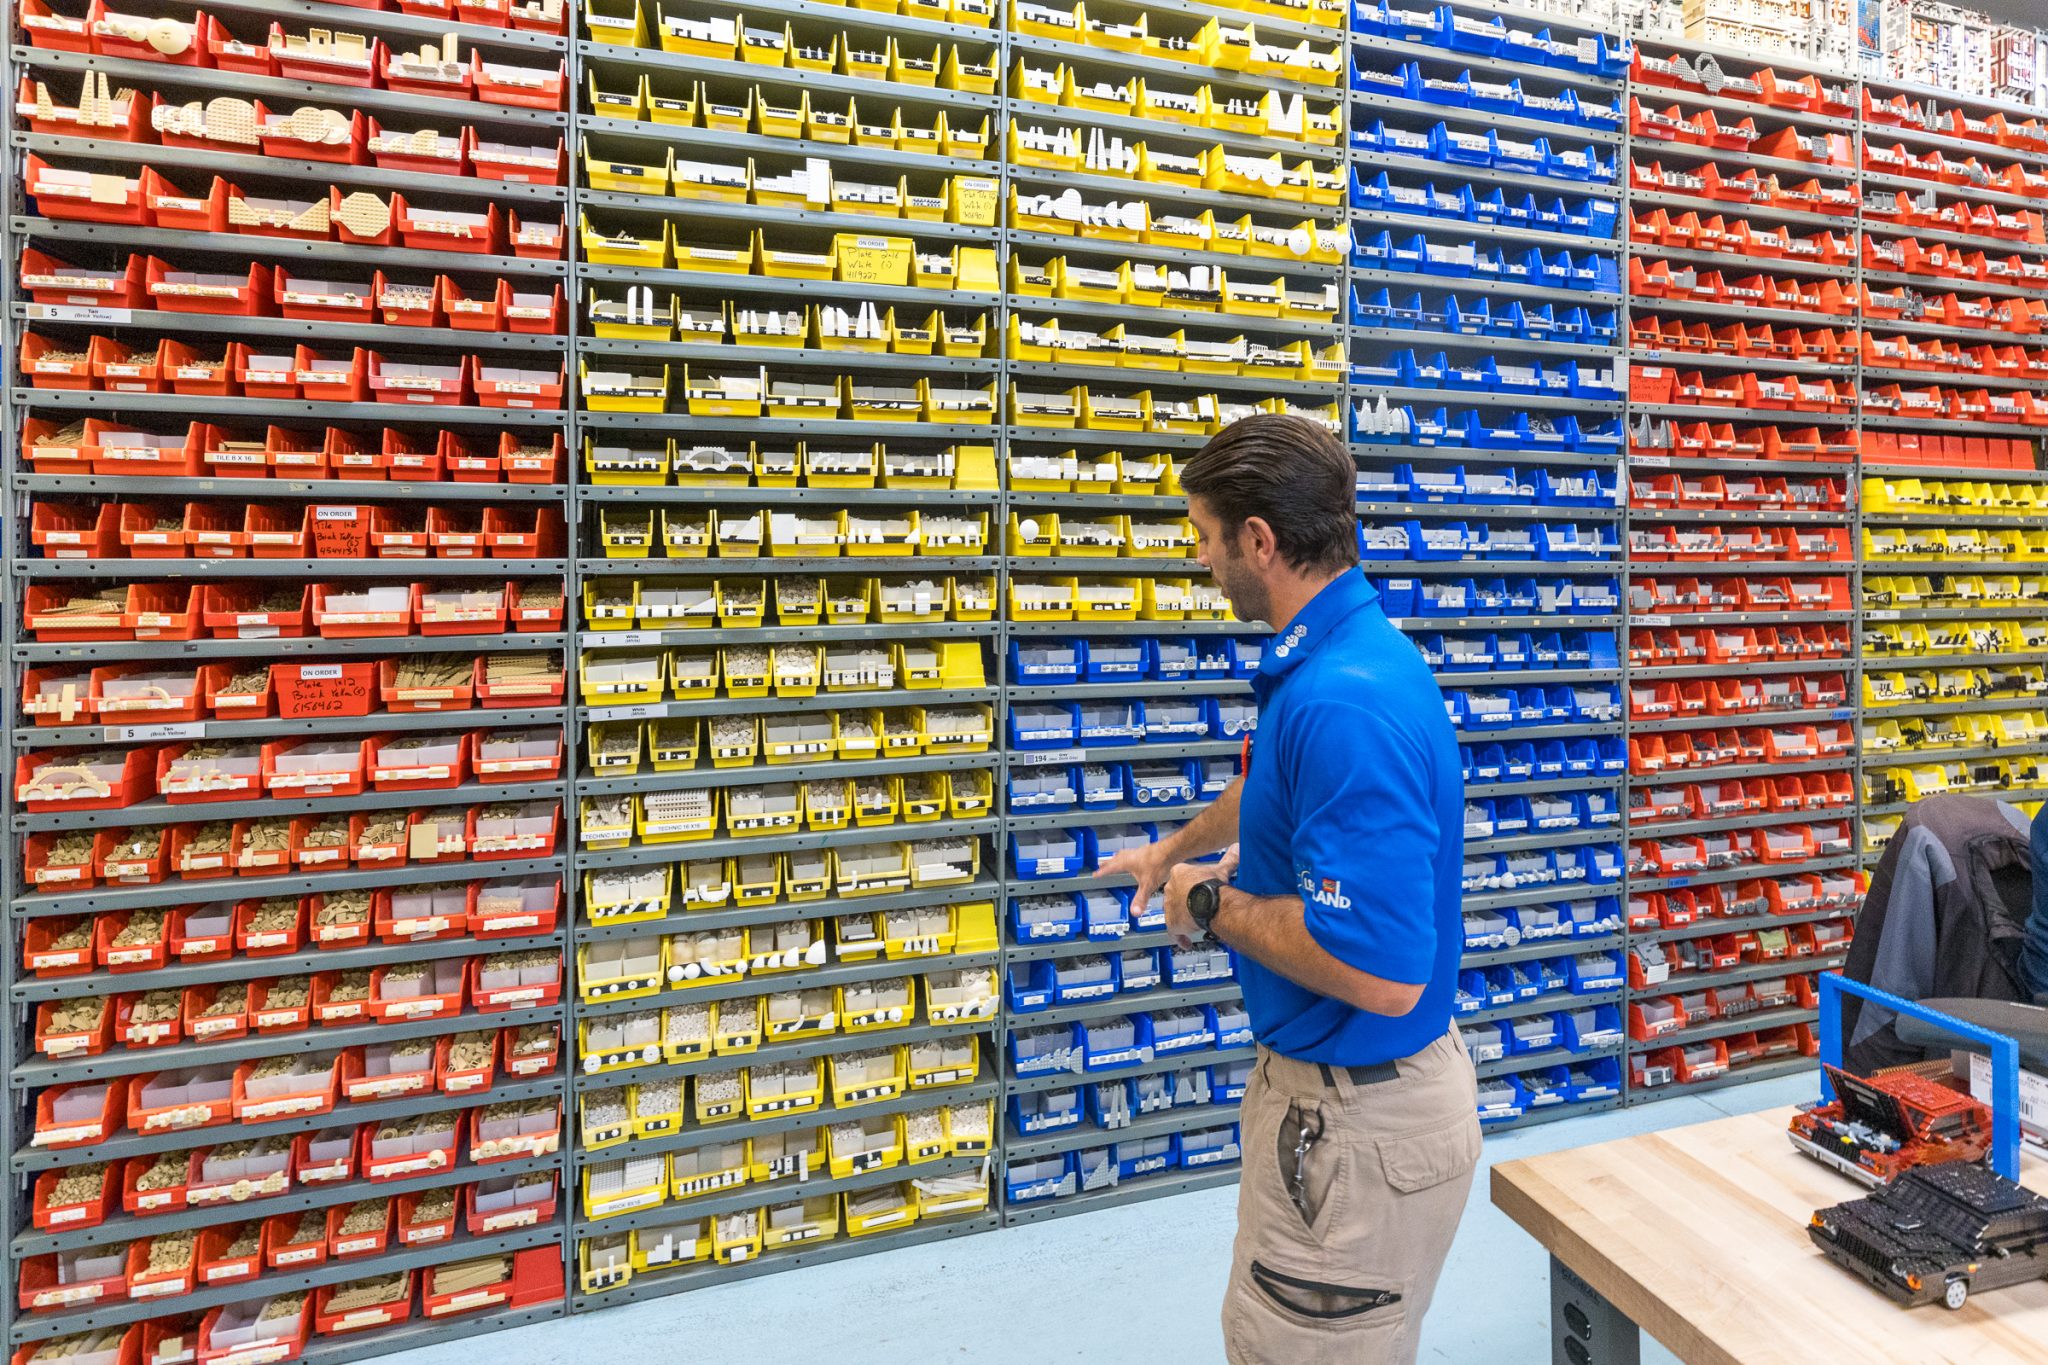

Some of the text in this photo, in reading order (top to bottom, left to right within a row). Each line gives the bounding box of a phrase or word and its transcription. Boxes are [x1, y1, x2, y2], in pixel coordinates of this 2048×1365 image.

[847, 247, 872, 257] Plate
[50, 308, 58, 317] 5
[315, 520, 332, 529] Tile
[295, 679, 323, 688] Plate
[293, 701, 343, 713] 6156462
[127, 729, 134, 738] 5
